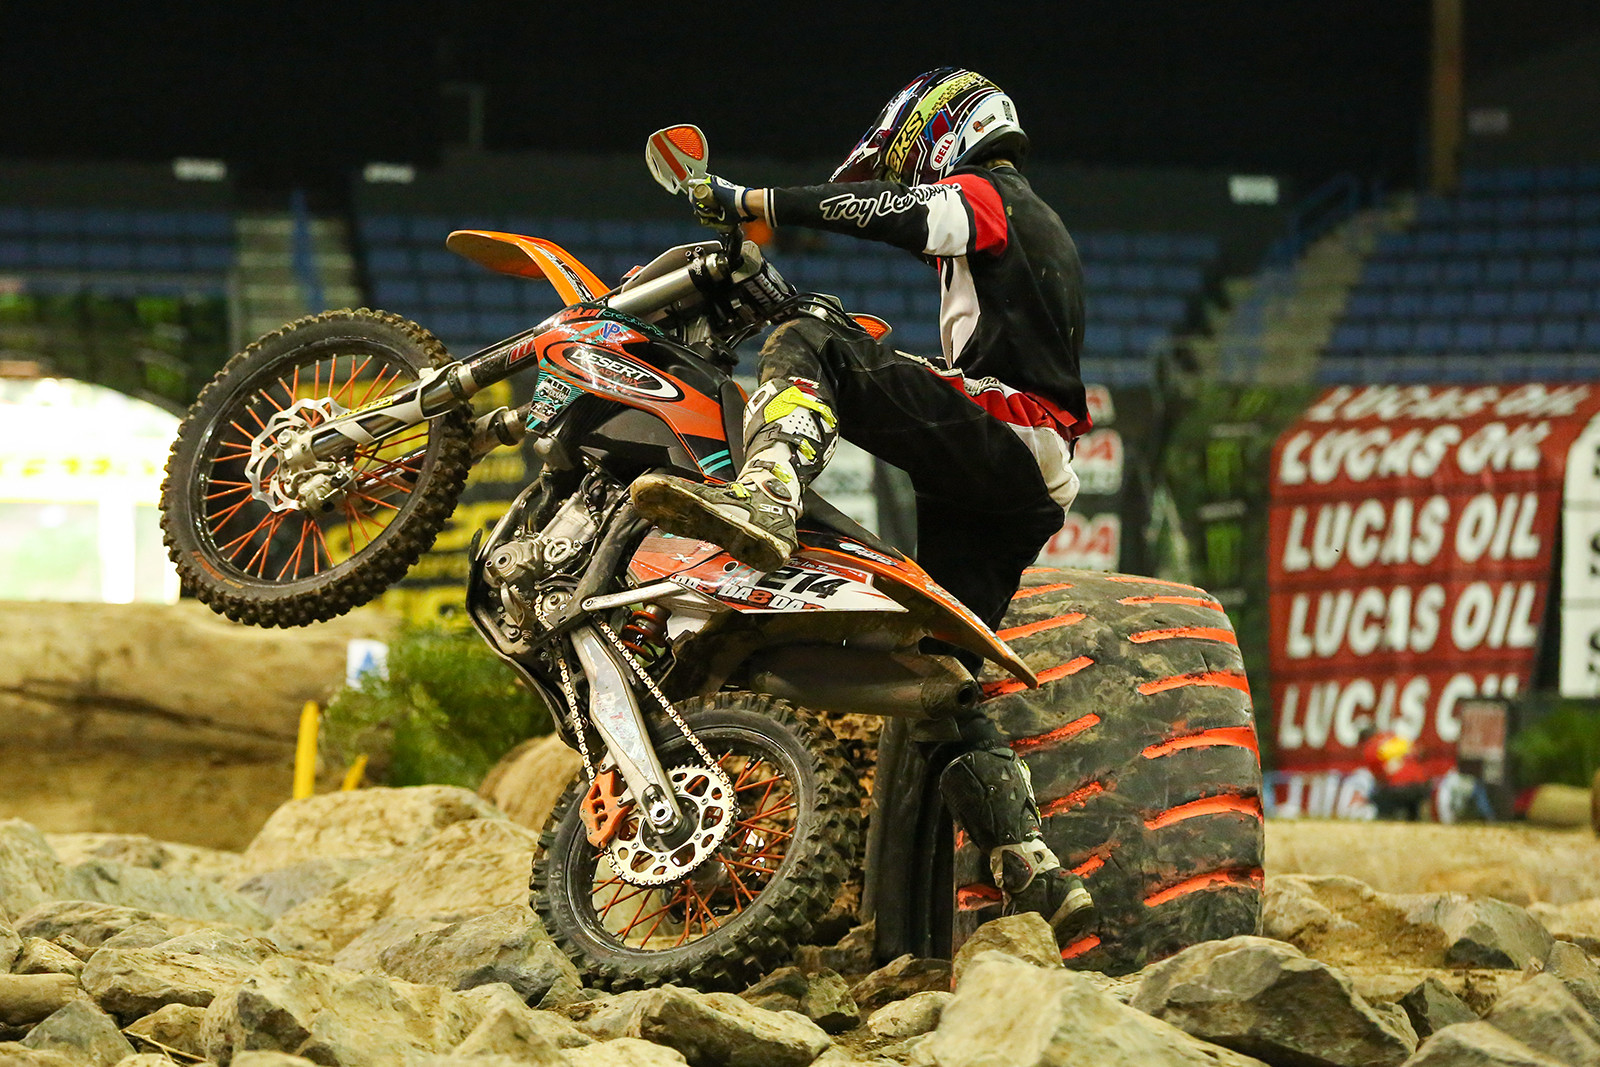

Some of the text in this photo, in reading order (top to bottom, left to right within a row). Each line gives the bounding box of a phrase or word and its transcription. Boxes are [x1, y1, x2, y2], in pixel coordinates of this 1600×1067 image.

[934, 138, 954, 165] BELL
[820, 193, 875, 228] Troy
[570, 348, 651, 380] DESERT
[1279, 421, 1551, 485] LUCAS OIL
[1283, 493, 1541, 572] LUCAS OIL
[1287, 581, 1538, 659] LUCAS OIL
